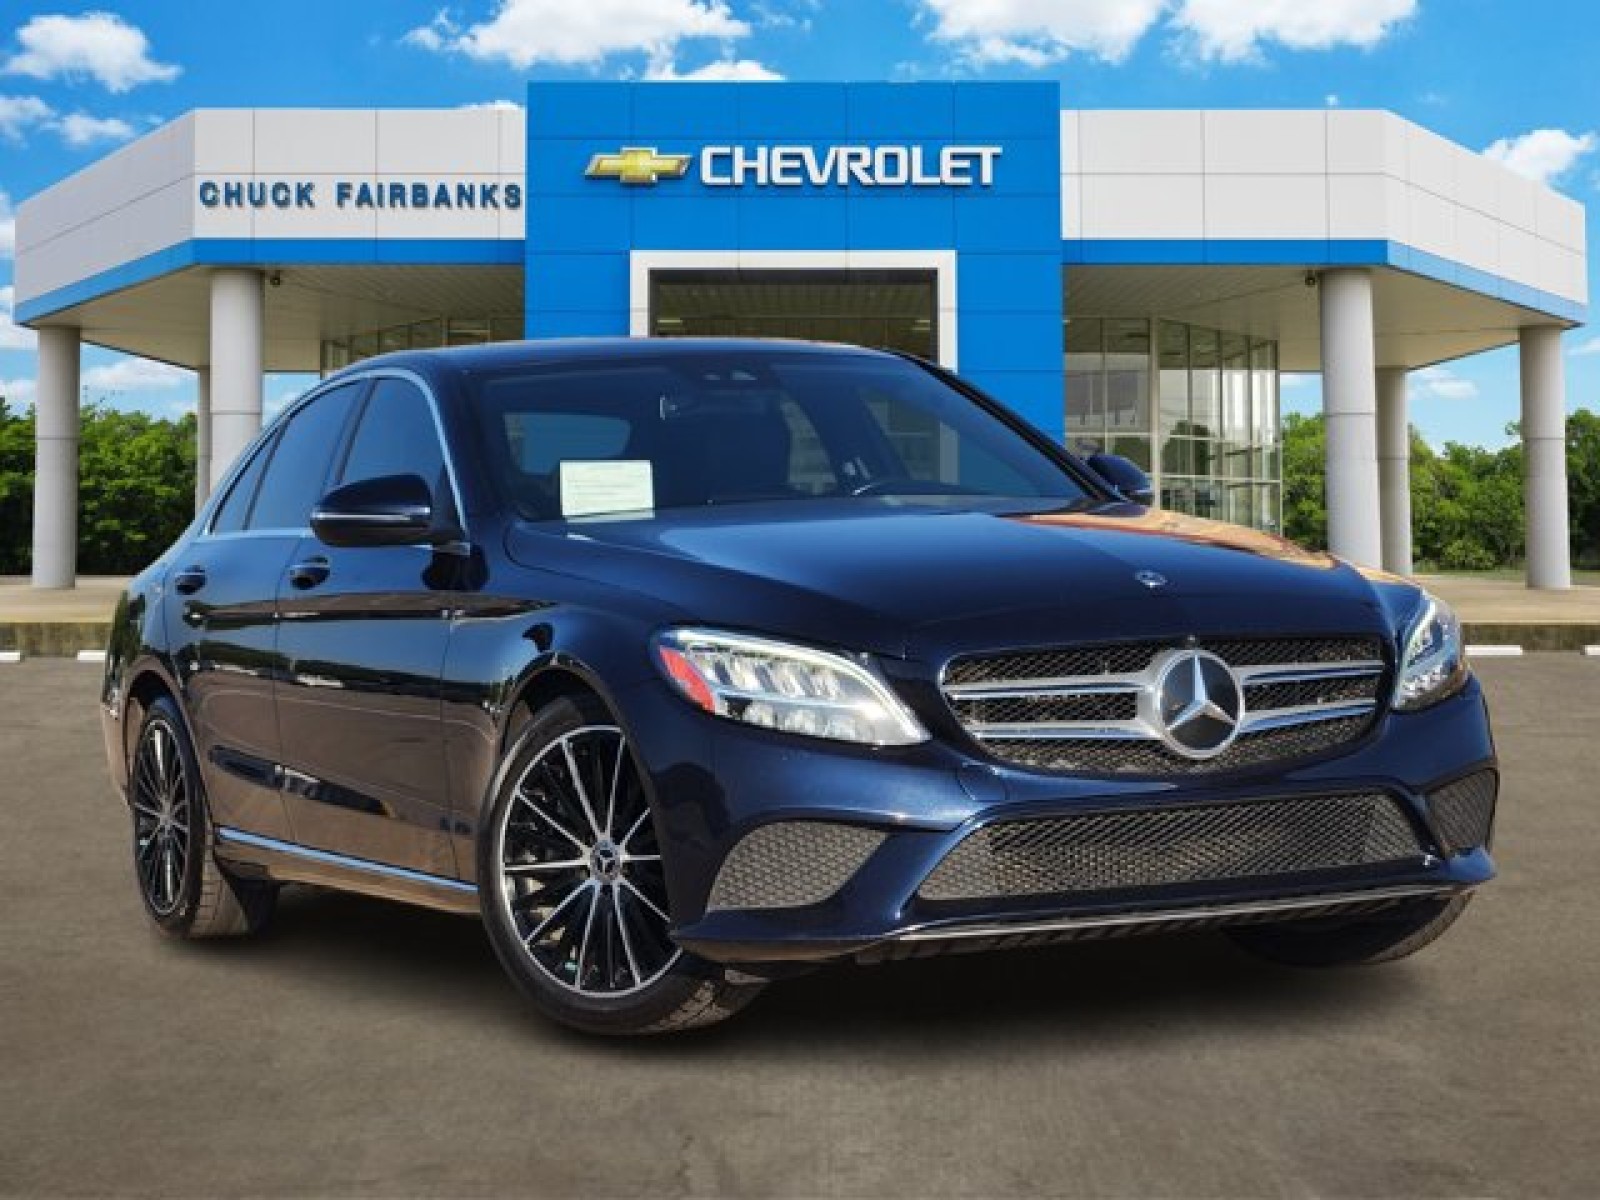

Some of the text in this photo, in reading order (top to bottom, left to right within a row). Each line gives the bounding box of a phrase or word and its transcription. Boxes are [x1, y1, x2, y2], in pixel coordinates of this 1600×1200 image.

[701, 145, 1003, 186] CHEVROLET
[199, 181, 522, 209] CHUCK FAIRBANKS
